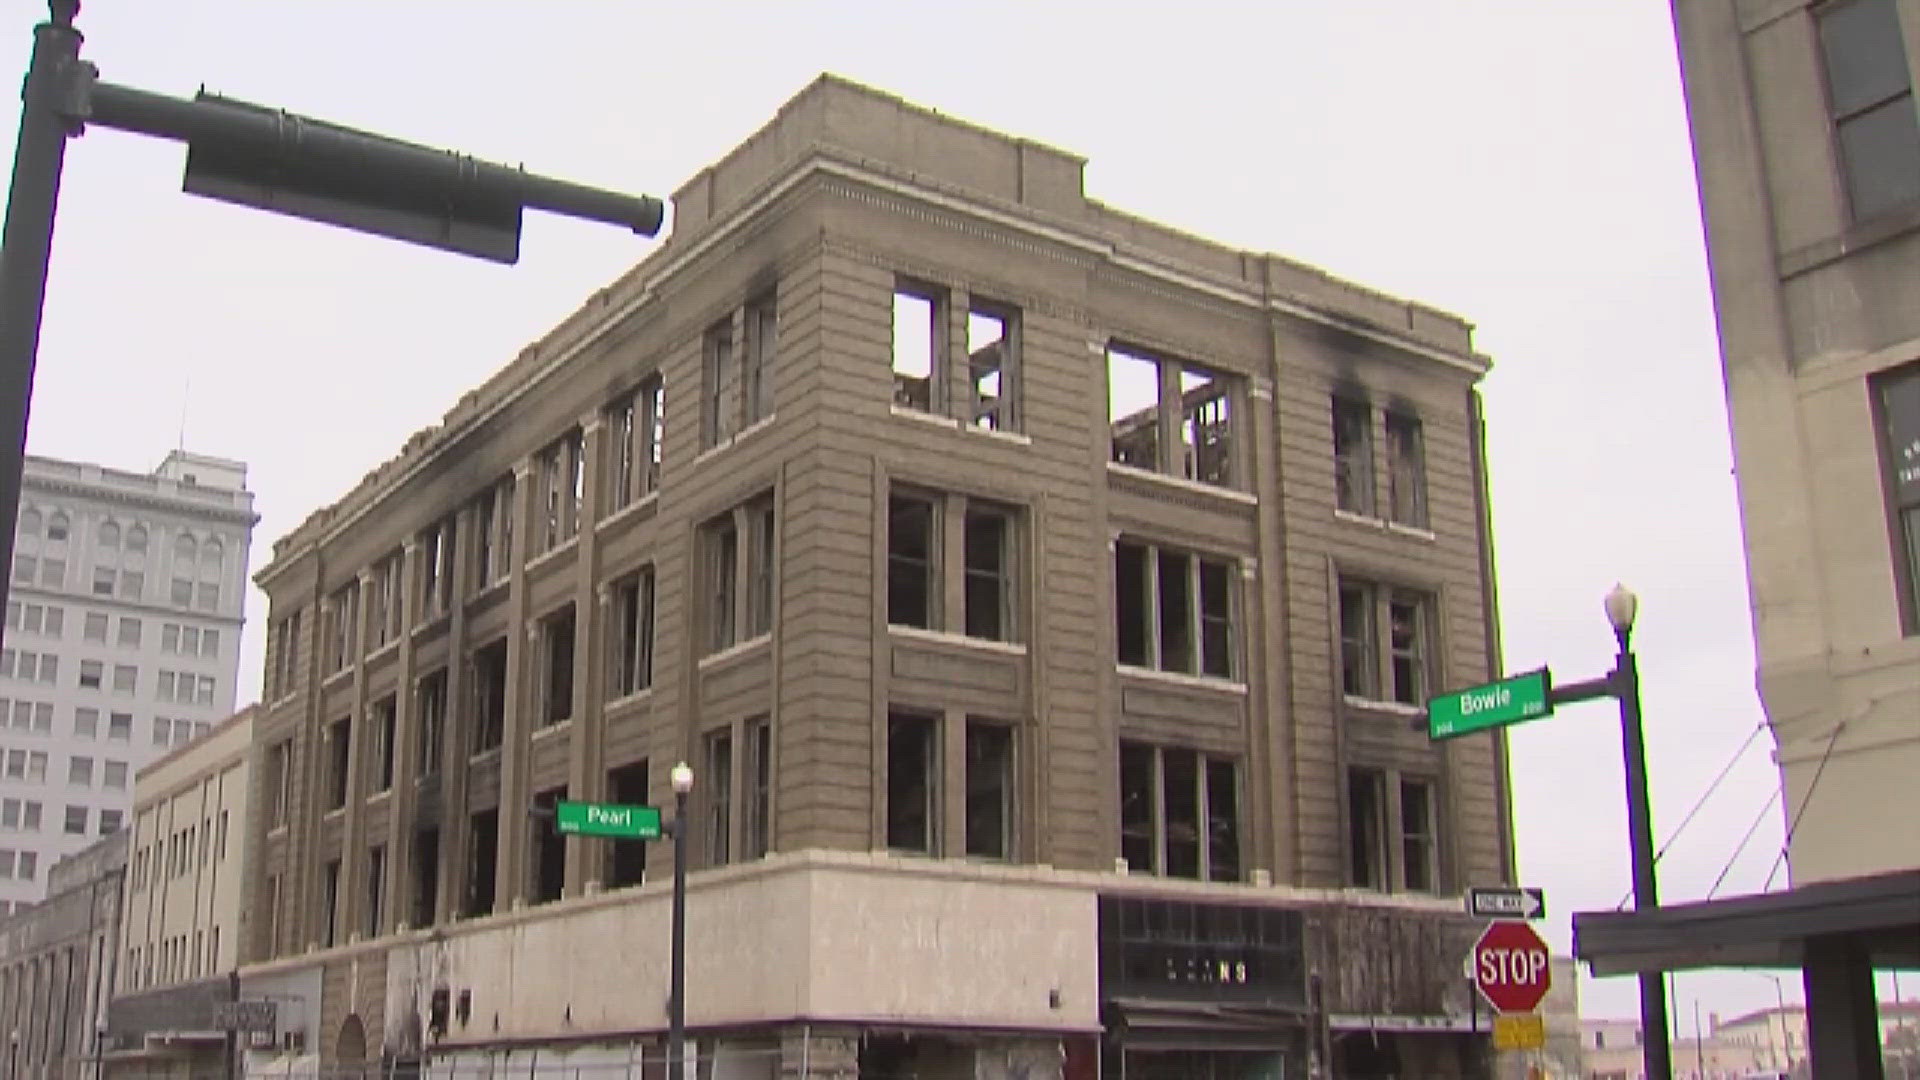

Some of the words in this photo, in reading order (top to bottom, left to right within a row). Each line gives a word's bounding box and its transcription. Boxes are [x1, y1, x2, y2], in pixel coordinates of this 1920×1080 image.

[1459, 685, 1511, 716] Bowie
[588, 804, 631, 827] Pearl
[1480, 949, 1545, 985] STOP
